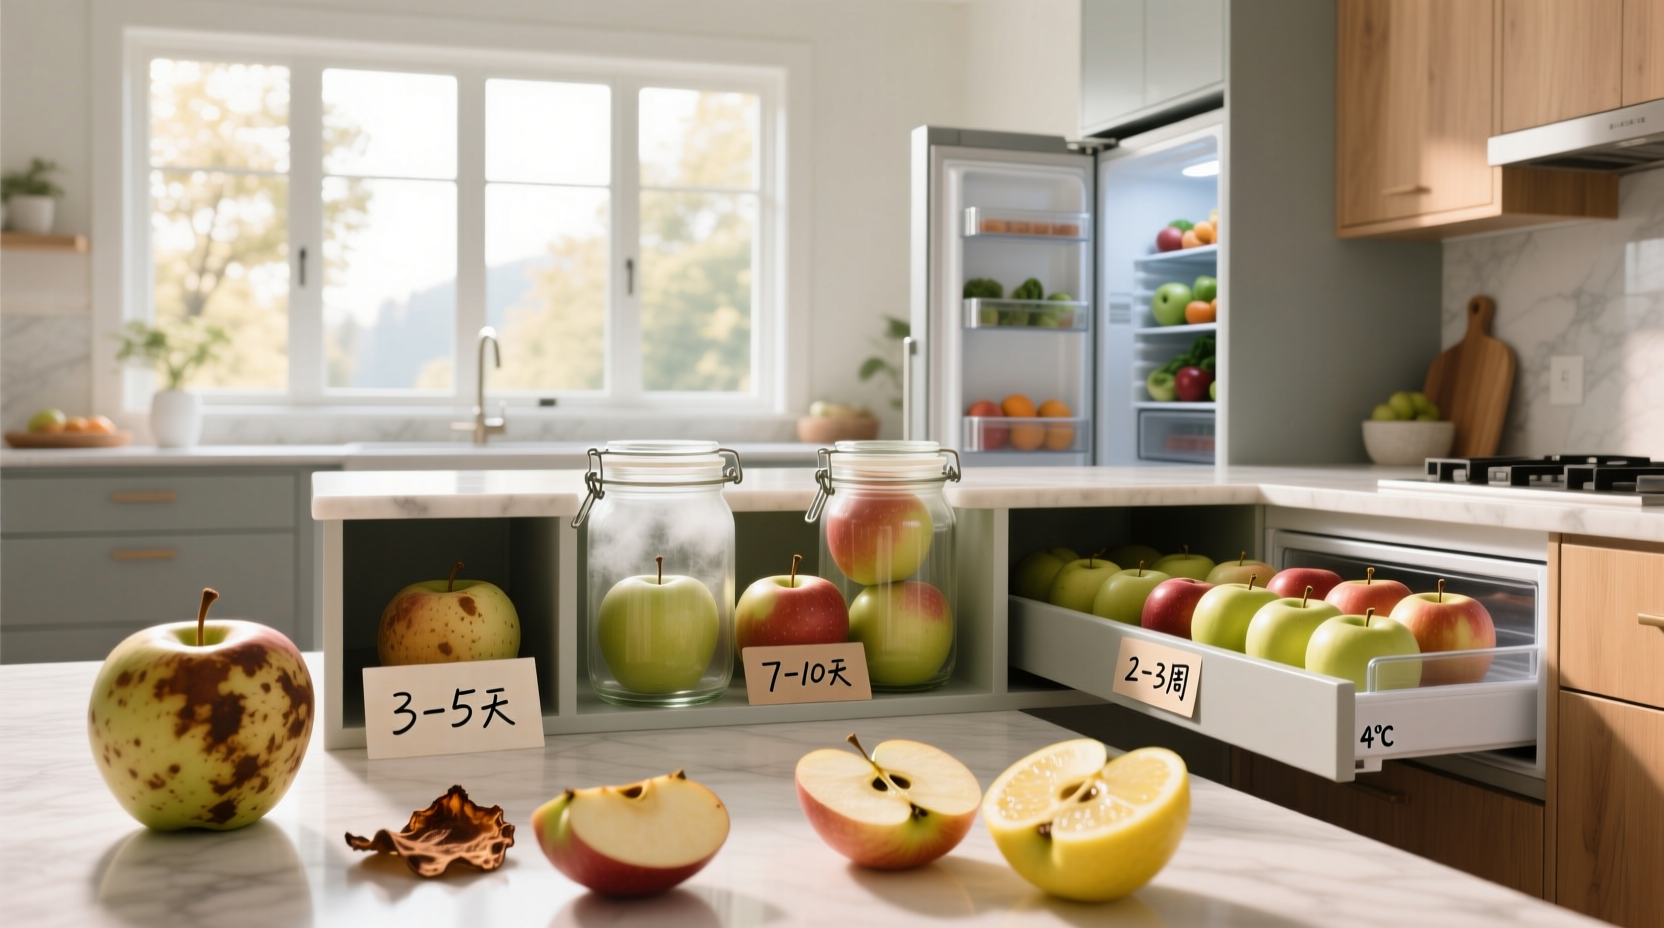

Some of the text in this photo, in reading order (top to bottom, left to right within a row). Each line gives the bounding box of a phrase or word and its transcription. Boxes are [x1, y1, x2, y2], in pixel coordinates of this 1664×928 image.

[761, 658, 852, 693] 7-10天
[1124, 656, 1190, 702] 2-3周
[392, 687, 516, 736] 3-5天
